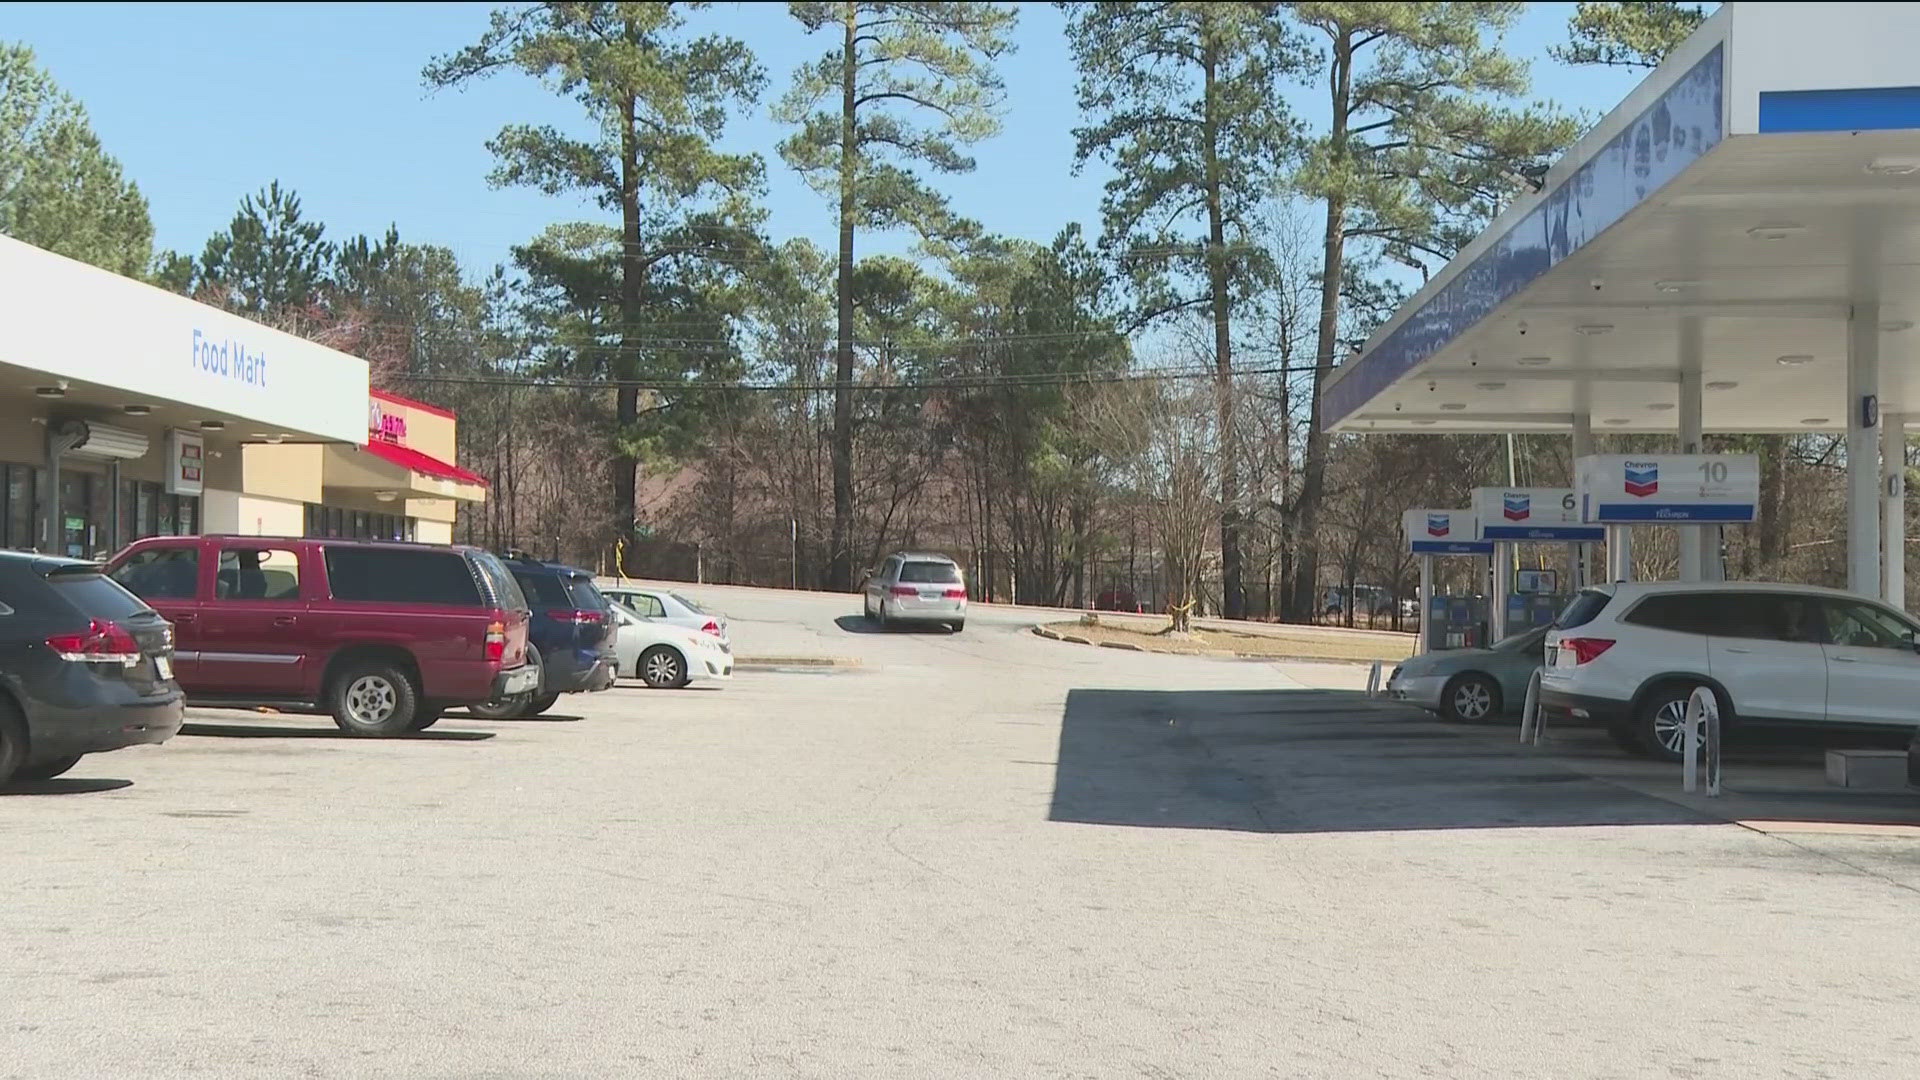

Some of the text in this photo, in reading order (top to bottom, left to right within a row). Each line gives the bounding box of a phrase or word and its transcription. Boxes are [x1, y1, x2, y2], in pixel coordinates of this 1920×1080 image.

[193, 328, 266, 388] Food Mart
[1624, 461, 1658, 469] Chevron
[1698, 461, 1728, 483] 10
[1561, 493, 1576, 511] 6
